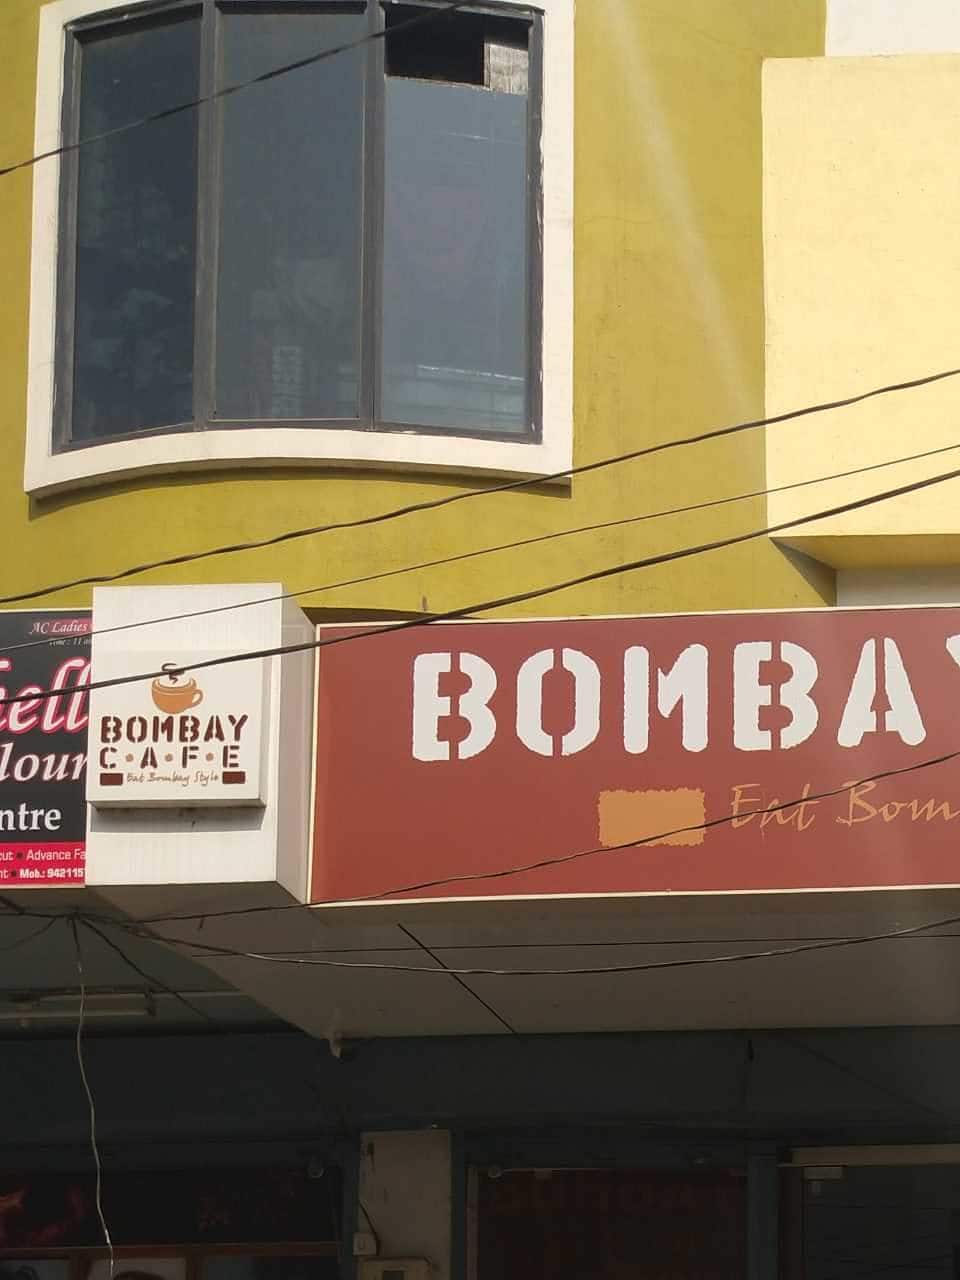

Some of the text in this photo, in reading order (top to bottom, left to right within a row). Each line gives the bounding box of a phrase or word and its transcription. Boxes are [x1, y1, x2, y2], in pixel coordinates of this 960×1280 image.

[51, 619, 88, 633] Ladies
[0, 657, 90, 733] ell
[100, 714, 248, 743] BOMBAY
[126, 770, 219, 786] Eat Bombay Style
[729, 782, 822, 832] Eat
[26, 849, 71, 861] Advance
